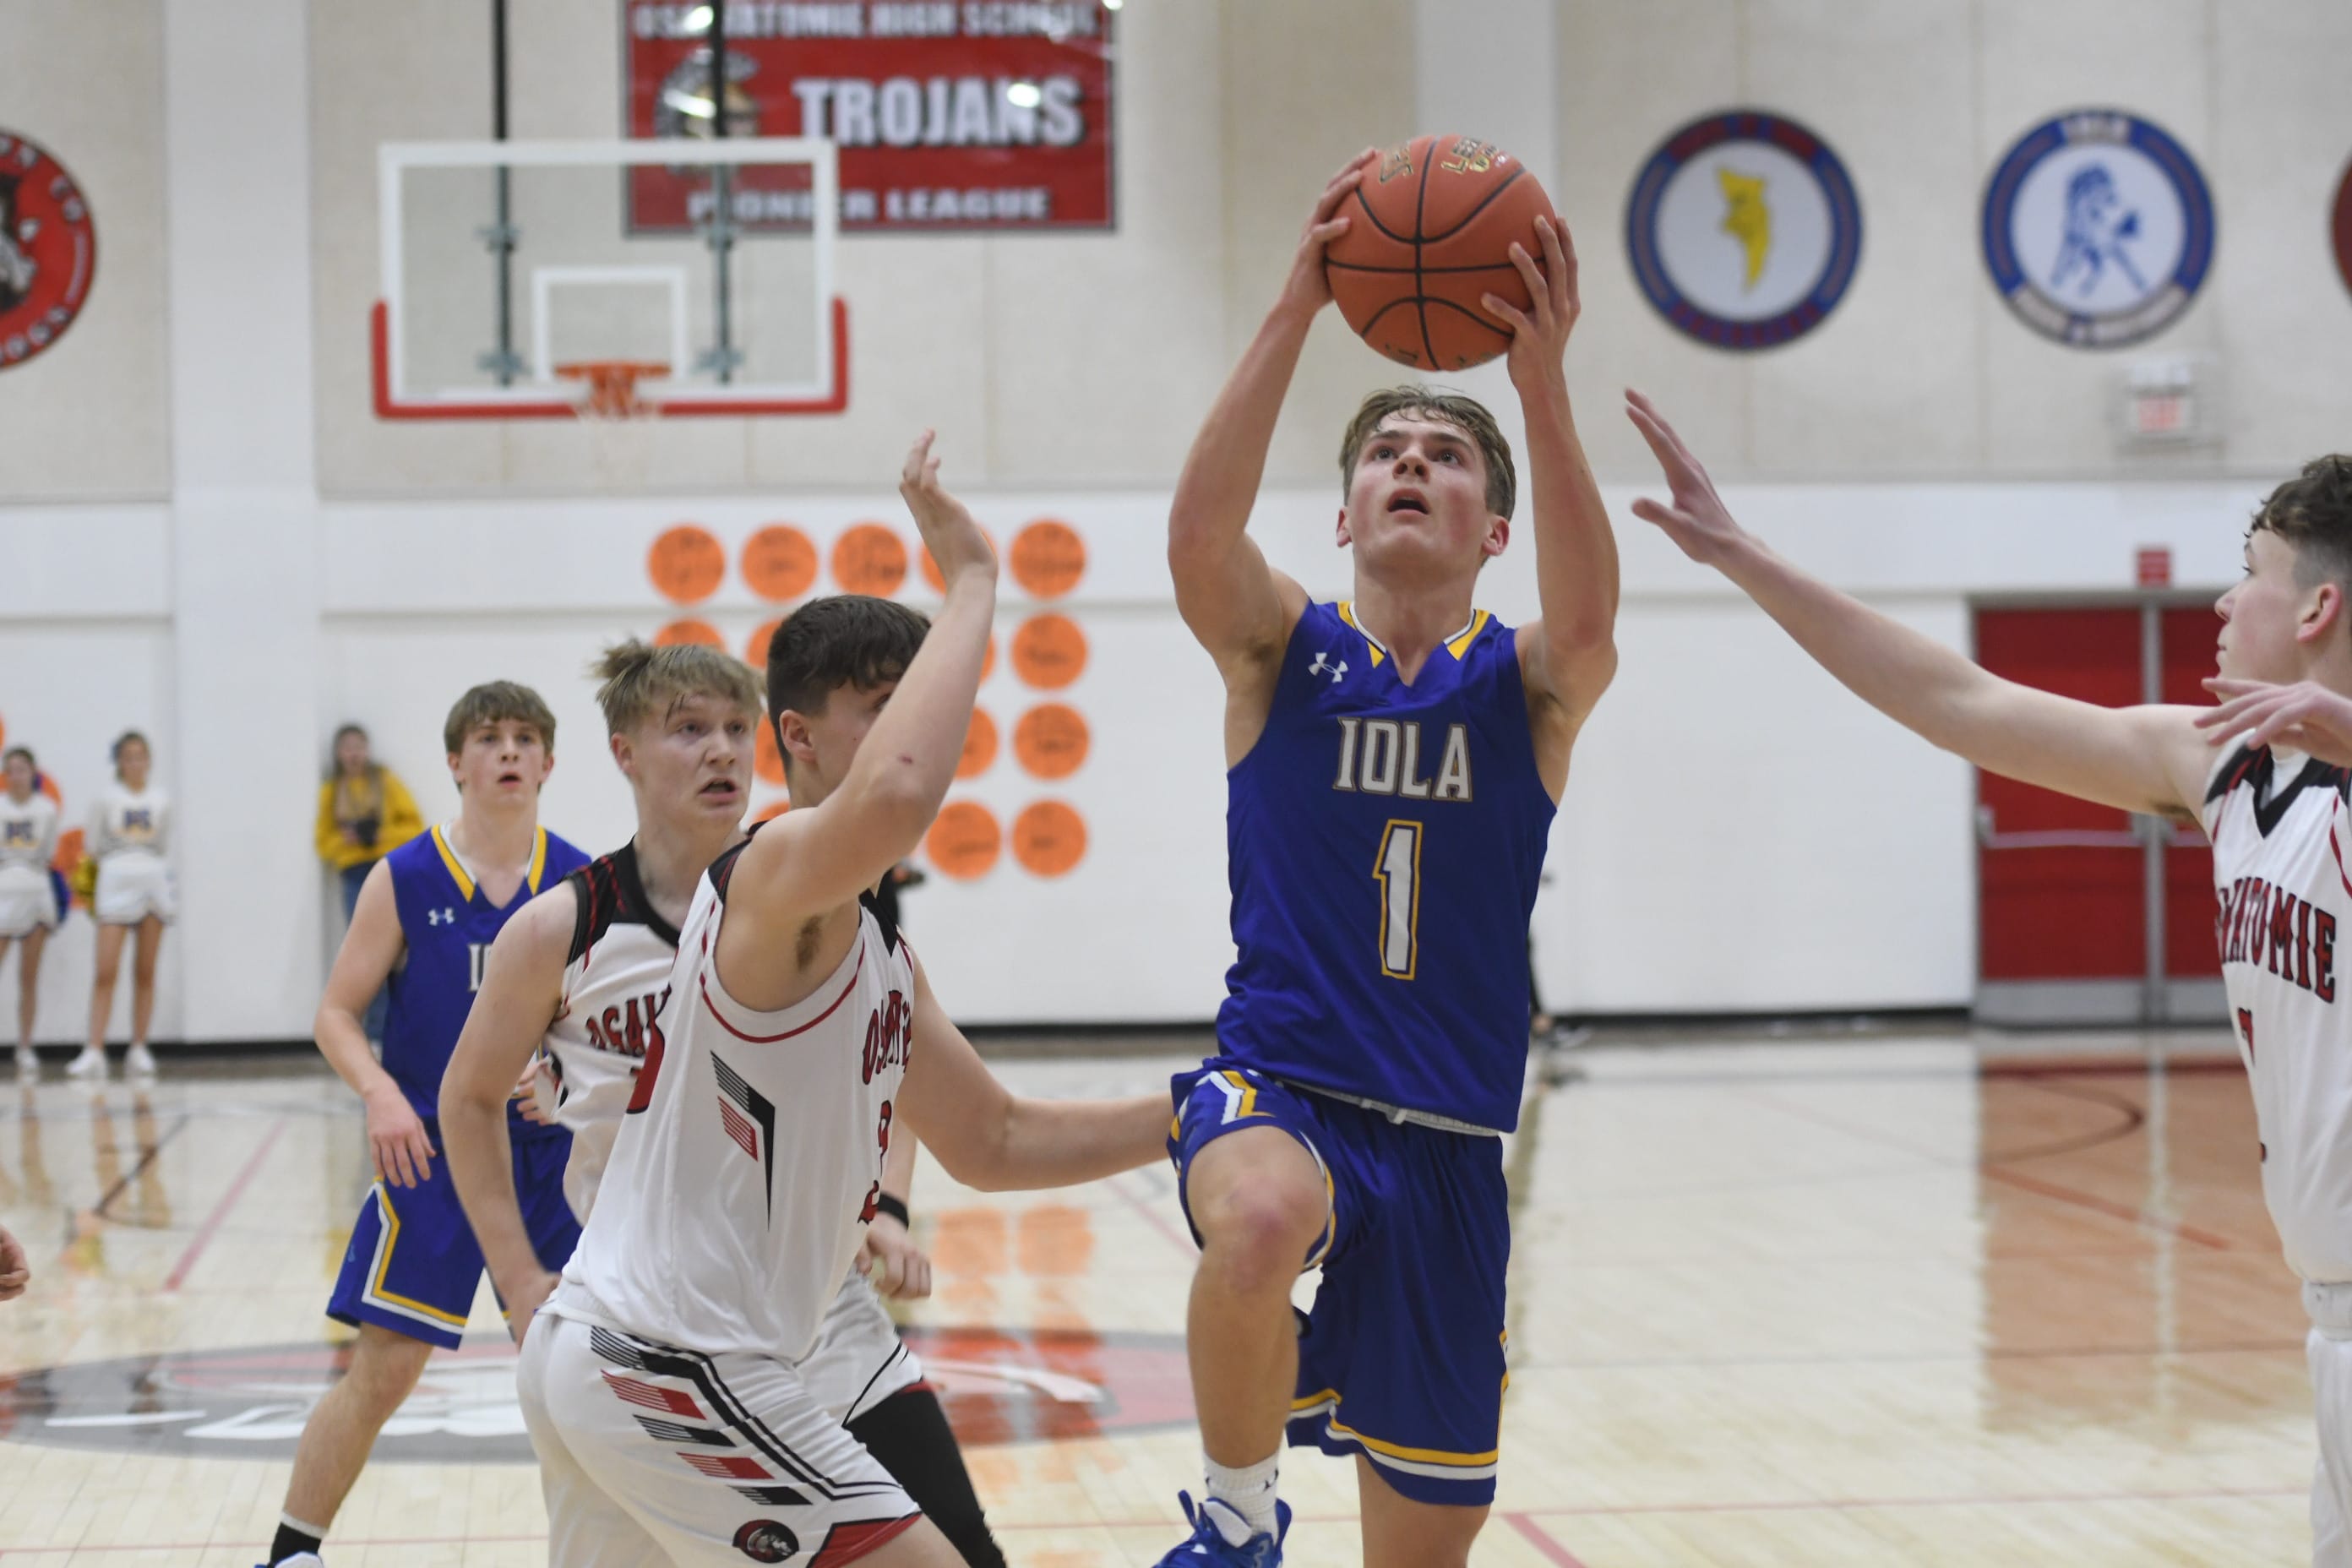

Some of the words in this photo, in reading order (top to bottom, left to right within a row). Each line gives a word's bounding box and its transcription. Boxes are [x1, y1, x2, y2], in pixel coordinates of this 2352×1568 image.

[792, 76, 1085, 147] TROJANS
[885, 187, 1051, 220] LEAGUE
[1332, 716, 1473, 802] IOLA
[1372, 819, 1423, 981] 1
